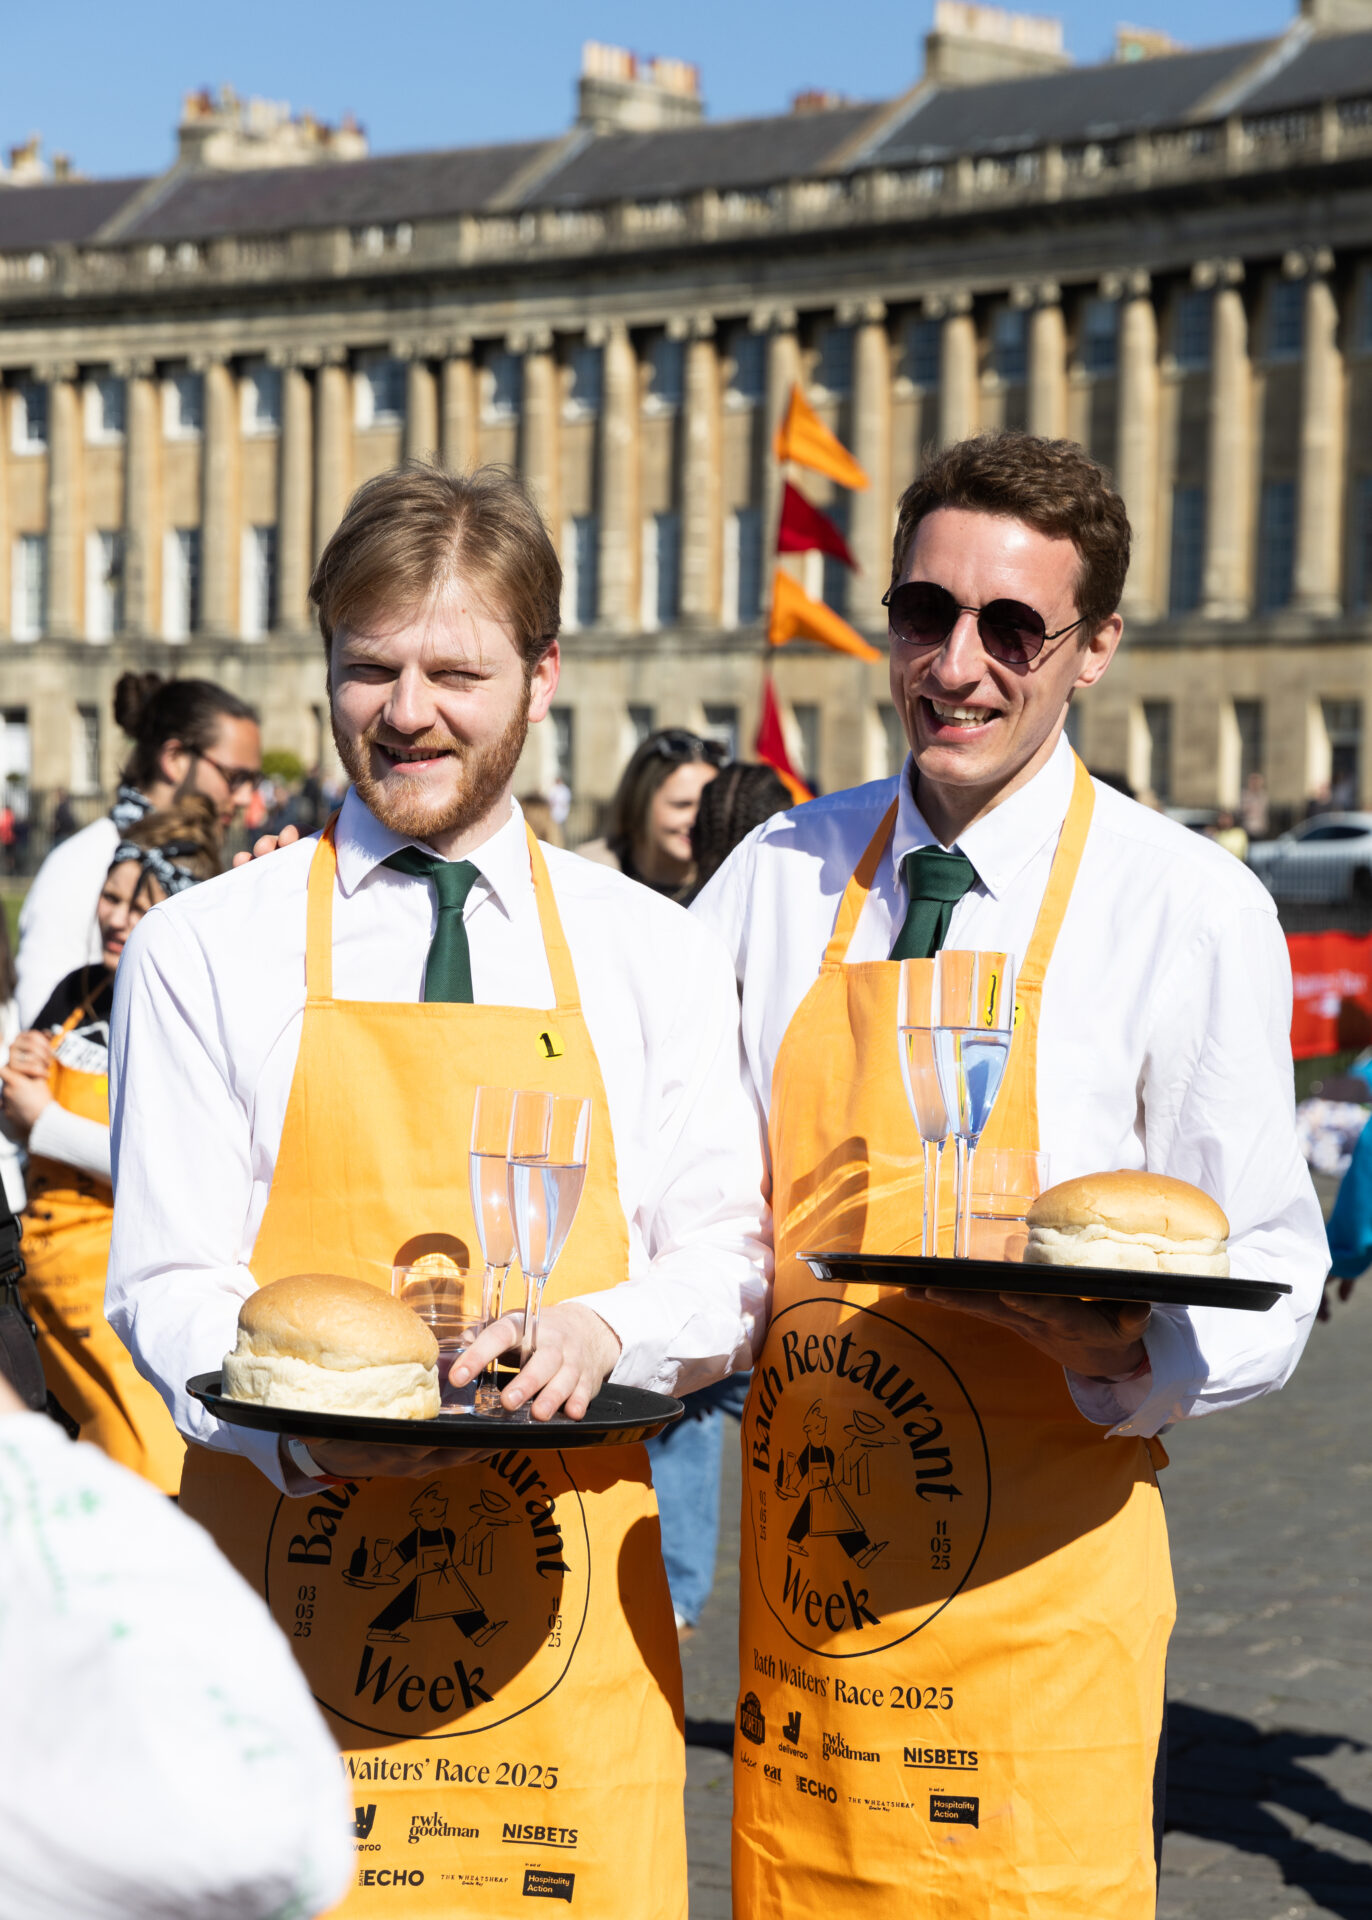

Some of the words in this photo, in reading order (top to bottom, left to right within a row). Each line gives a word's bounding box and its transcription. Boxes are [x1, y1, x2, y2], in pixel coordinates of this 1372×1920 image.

[540, 1032, 563, 1058] 1
[752, 1366, 784, 1473] Bath
[782, 1330, 963, 1503] Restaurant
[287, 1477, 374, 1565] Bat
[479, 1450, 572, 1579] urant
[930, 1538, 951, 1553] 05
[930, 1555, 951, 1570] 25
[298, 1585, 317, 1601] 03
[782, 1554, 881, 1632] Week
[295, 1604, 315, 1620] 05
[293, 1621, 312, 1637] 25
[548, 1614, 563, 1630] 05
[547, 1632, 562, 1648] 25
[354, 1645, 495, 1713] Week
[753, 1648, 776, 1680] Bath
[779, 1659, 830, 1698] Waiters’
[835, 1678, 884, 1707] Race
[890, 1685, 954, 1711] 2025
[822, 1732, 845, 1749] rwk
[778, 1742, 808, 1760] deliveroo
[822, 1742, 880, 1763] goodman
[903, 1747, 979, 1766] NISBETS
[339, 1756, 431, 1781] Waiters’
[435, 1758, 490, 1784] Race
[495, 1762, 559, 1790] 2025
[763, 1763, 782, 1783] eat
[800, 1776, 838, 1804] ECHO
[934, 1800, 975, 1812] Hospitality
[934, 1810, 959, 1819] Action
[411, 1812, 443, 1827] rwk
[408, 1822, 480, 1844] goodman
[502, 1823, 579, 1844] NISBETS
[353, 1843, 382, 1852] veroo
[364, 1870, 425, 1887] ECHO
[528, 1874, 570, 1887] Hospitality
[527, 1884, 553, 1893] Action
